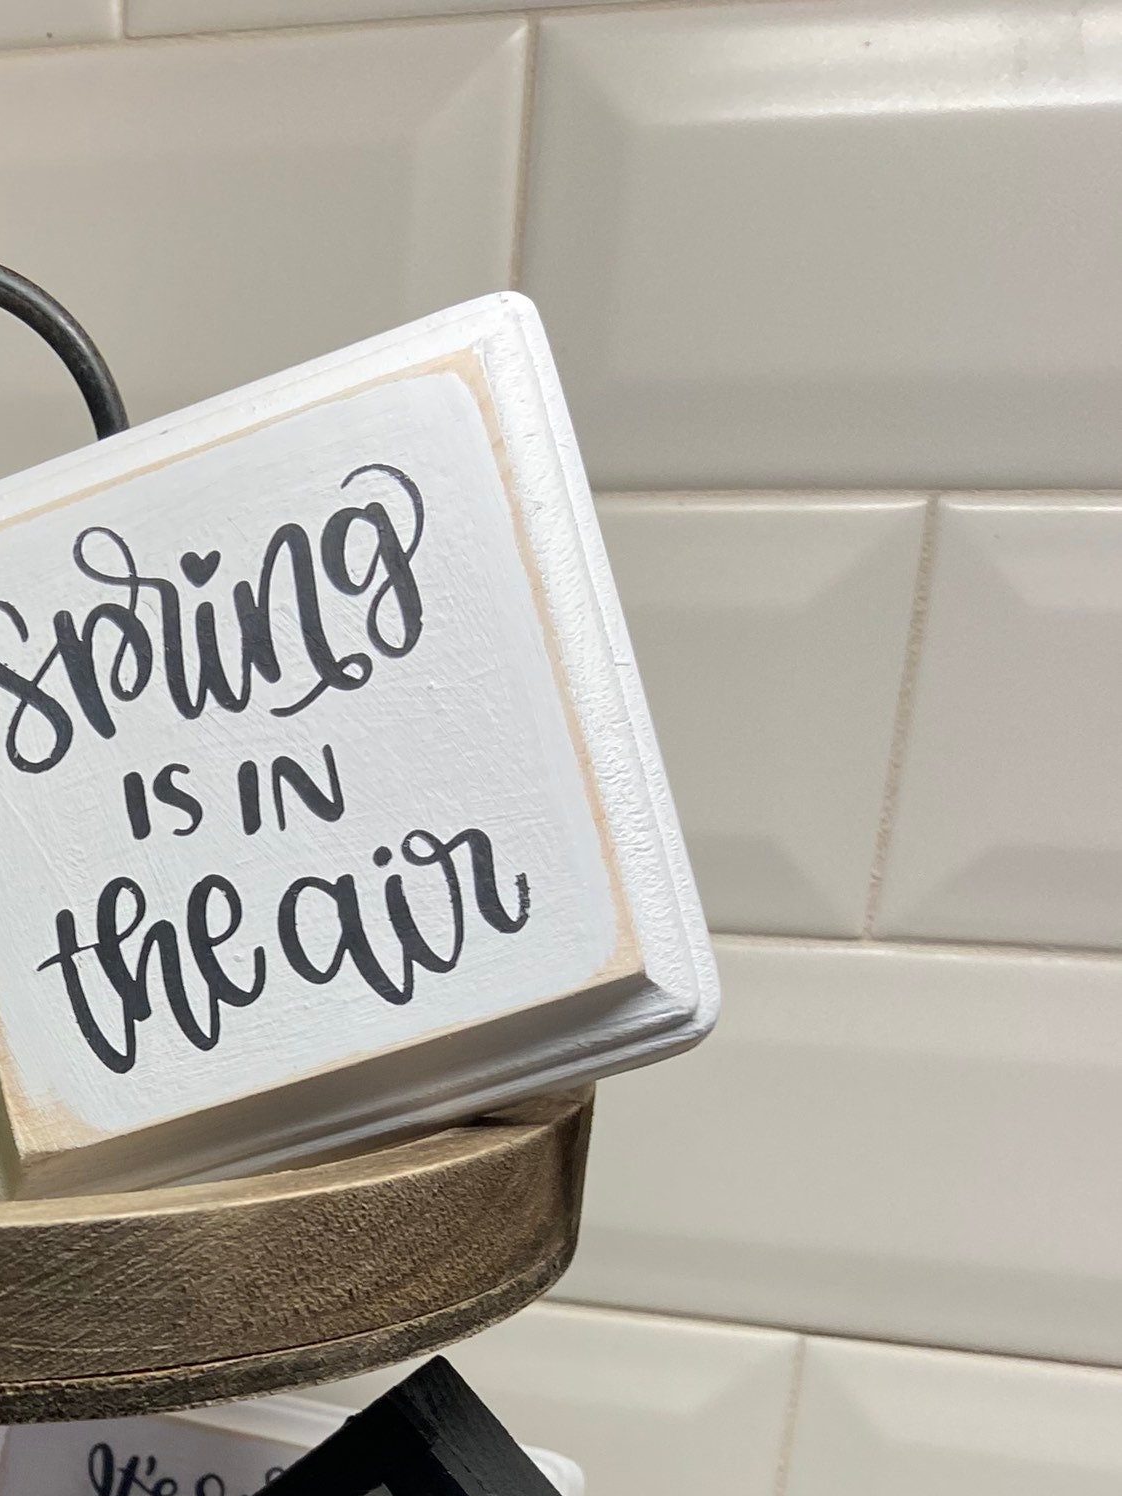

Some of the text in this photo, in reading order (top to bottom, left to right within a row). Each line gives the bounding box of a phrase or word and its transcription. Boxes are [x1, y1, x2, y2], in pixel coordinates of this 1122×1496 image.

[123, 744, 345, 839] IS IN
[37, 828, 531, 1074] the air
